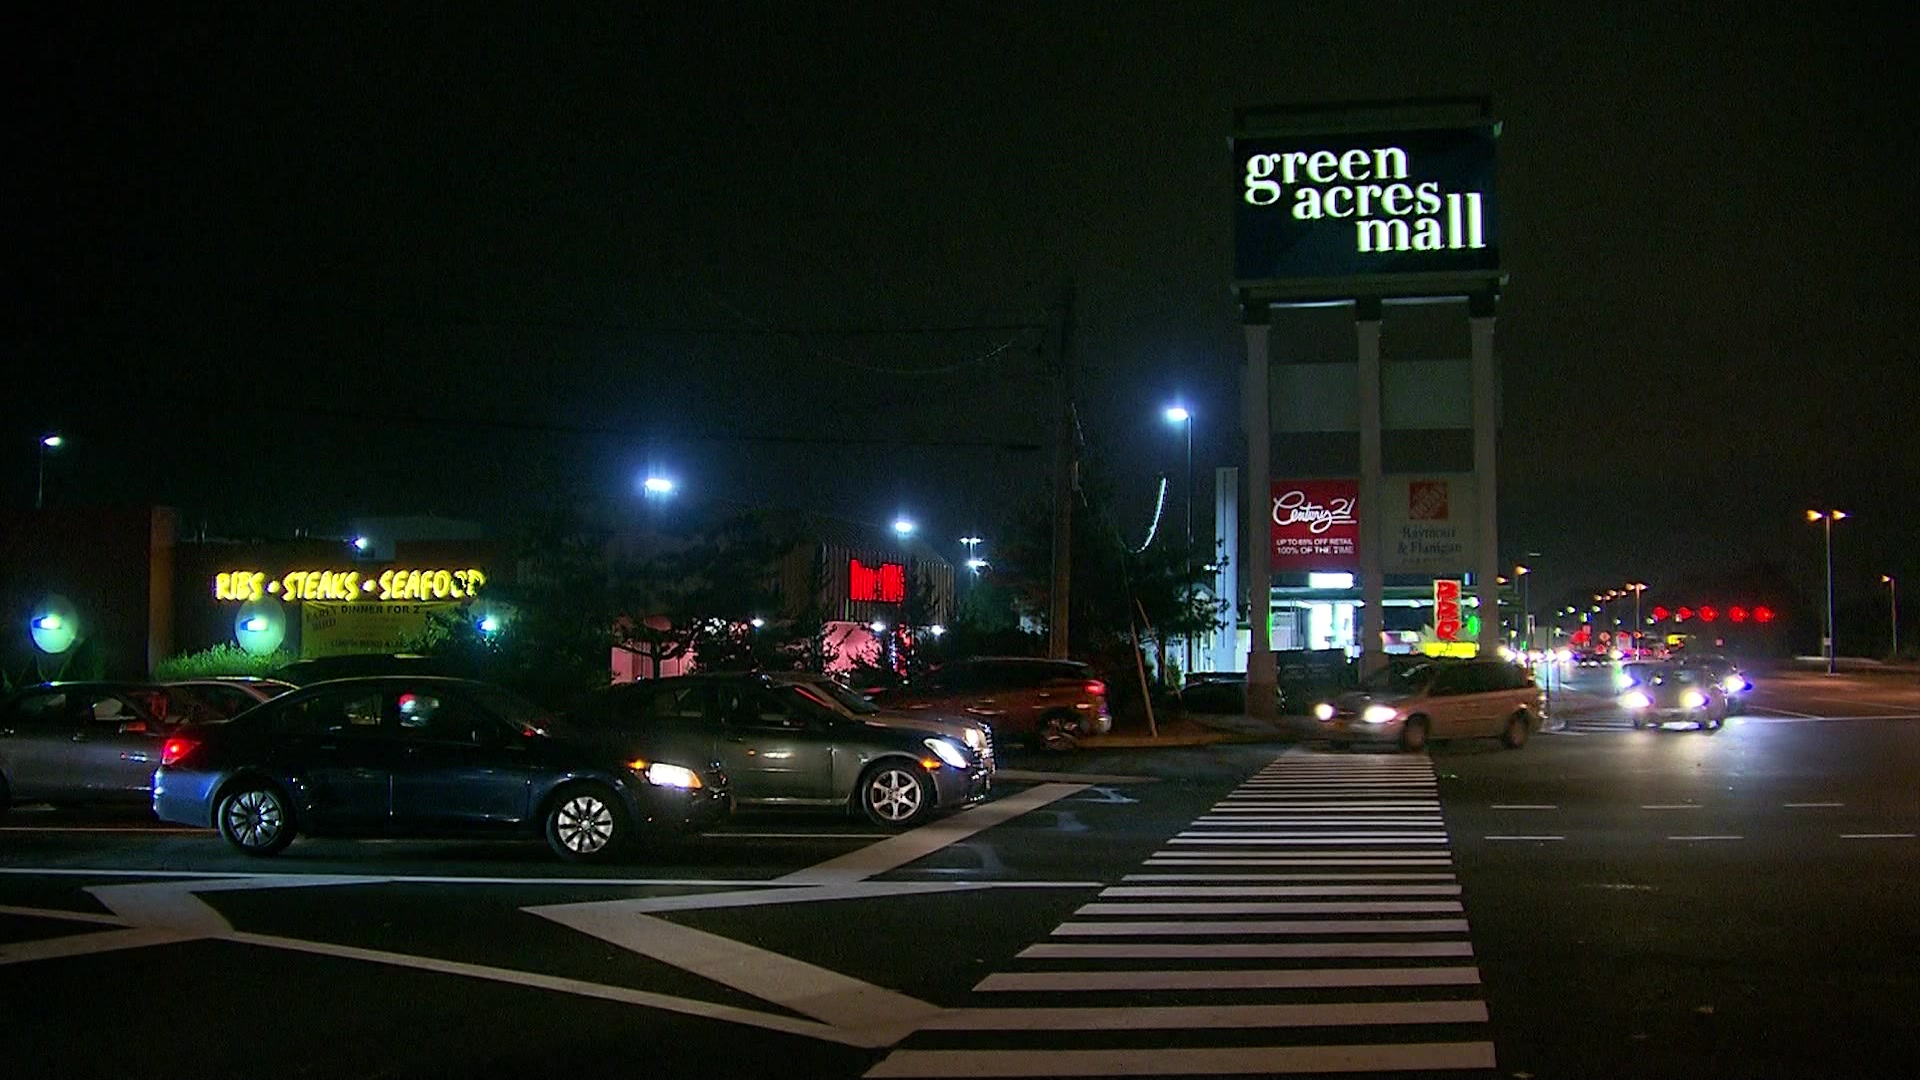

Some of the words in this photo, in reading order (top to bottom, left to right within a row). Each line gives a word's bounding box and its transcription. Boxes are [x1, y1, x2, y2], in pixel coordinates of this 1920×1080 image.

[1244, 147, 1411, 206] green
[1292, 181, 1442, 219] acres
[1354, 192, 1487, 253] mall
[1272, 490, 1333, 534] Century
[1287, 538, 1298, 547] TO
[1313, 538, 1329, 547] OFF
[216, 571, 265, 600] RIBS
[283, 570, 361, 601] STEAKS
[341, 605, 382, 615] DINNER
[387, 605, 410, 615] FOR
